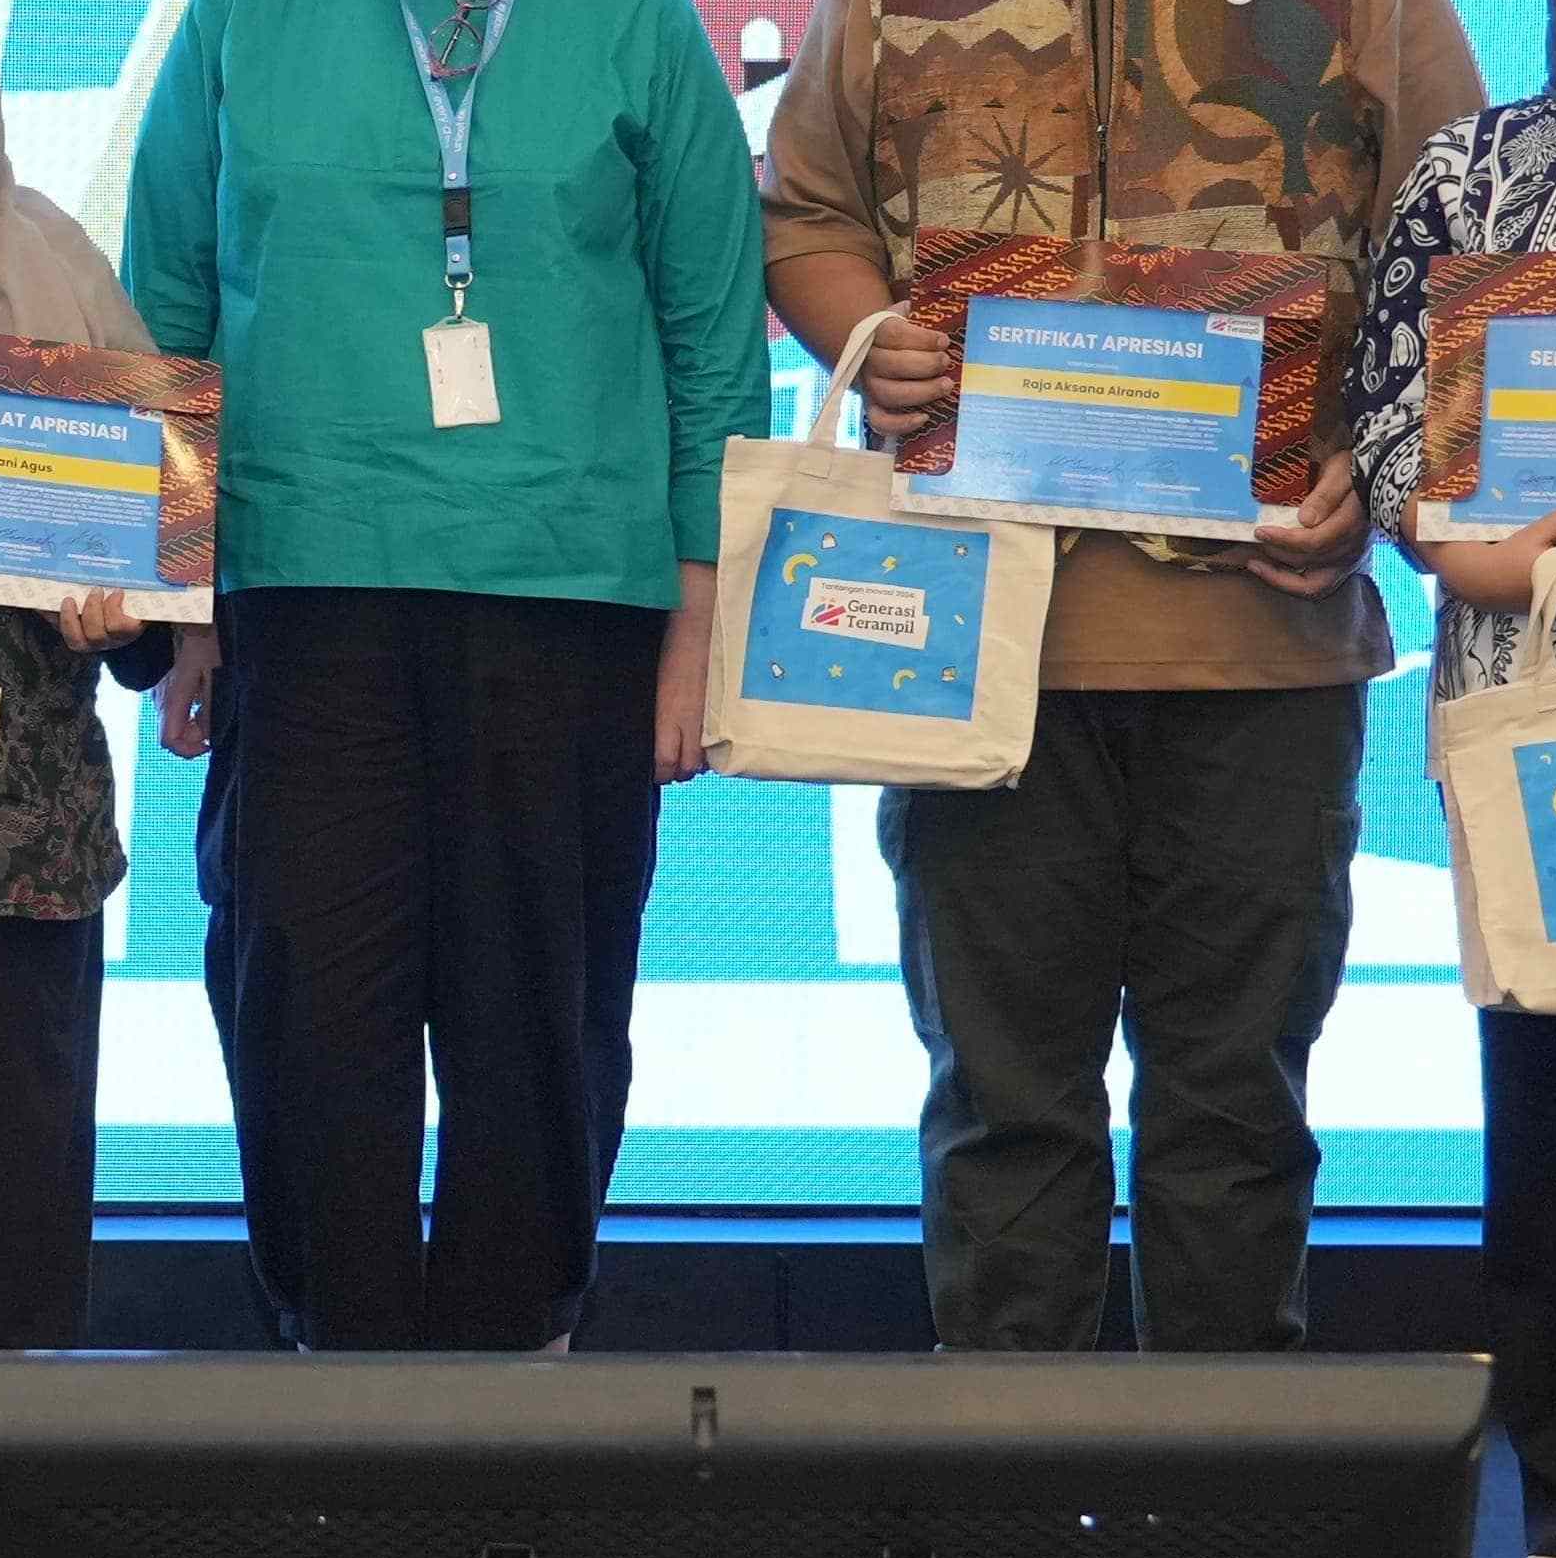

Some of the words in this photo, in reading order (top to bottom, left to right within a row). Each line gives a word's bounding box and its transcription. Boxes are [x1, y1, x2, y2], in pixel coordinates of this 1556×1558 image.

[988, 325, 1096, 351] SERTIFIKAT
[1101, 335, 1204, 359] APRESIASI
[30, 415, 128, 442] APRESIASI
[20, 460, 54, 474] Agus
[848, 599, 916, 618] Generasi
[847, 615, 914, 635] Terampil
